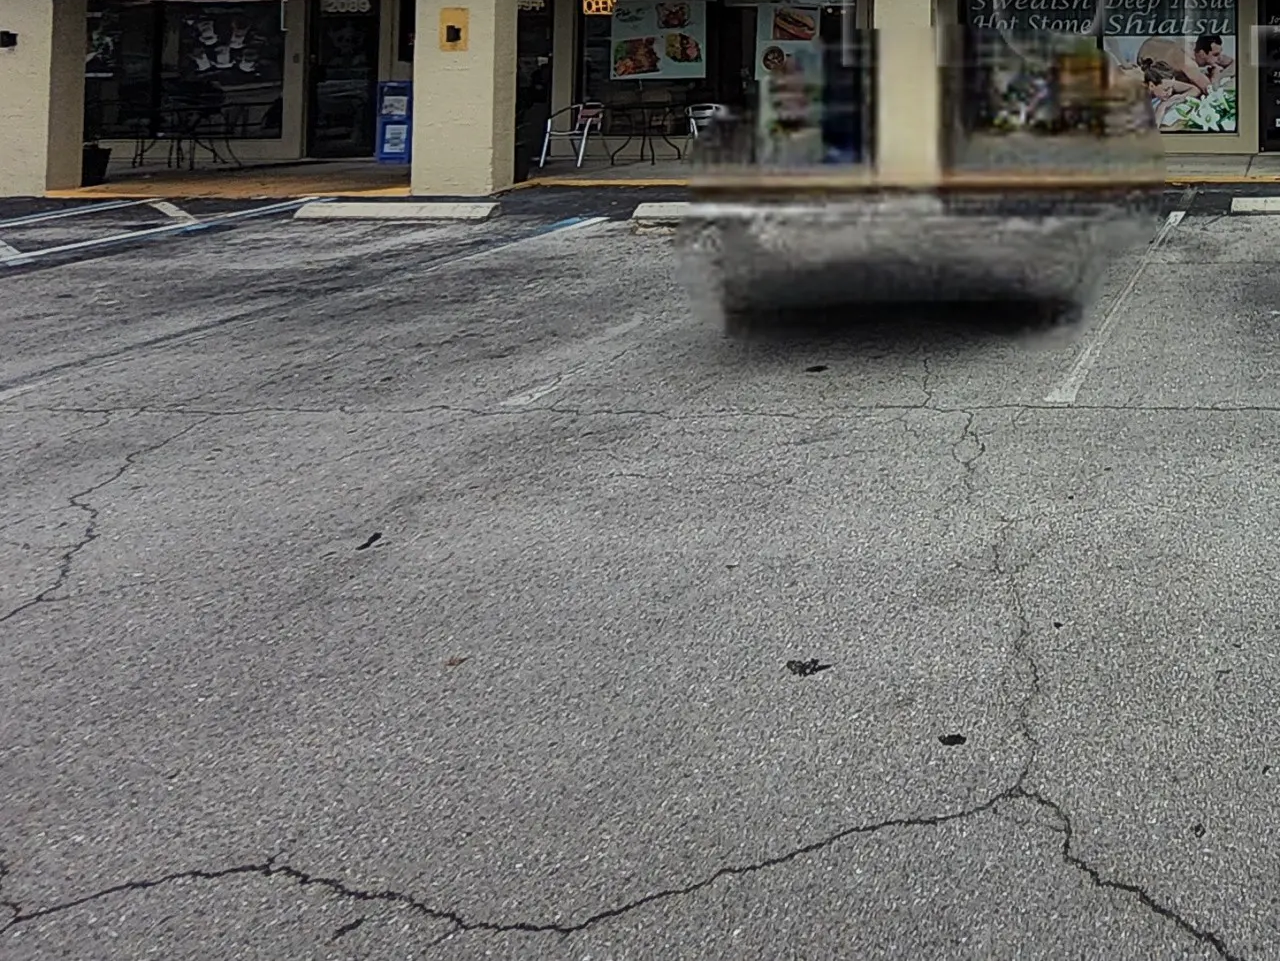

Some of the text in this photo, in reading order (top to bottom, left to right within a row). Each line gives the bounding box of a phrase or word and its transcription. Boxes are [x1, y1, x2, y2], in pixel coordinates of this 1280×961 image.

[973, 11, 1092, 35] Hot Stone
[1104, 10, 1233, 35] Shiatsu
